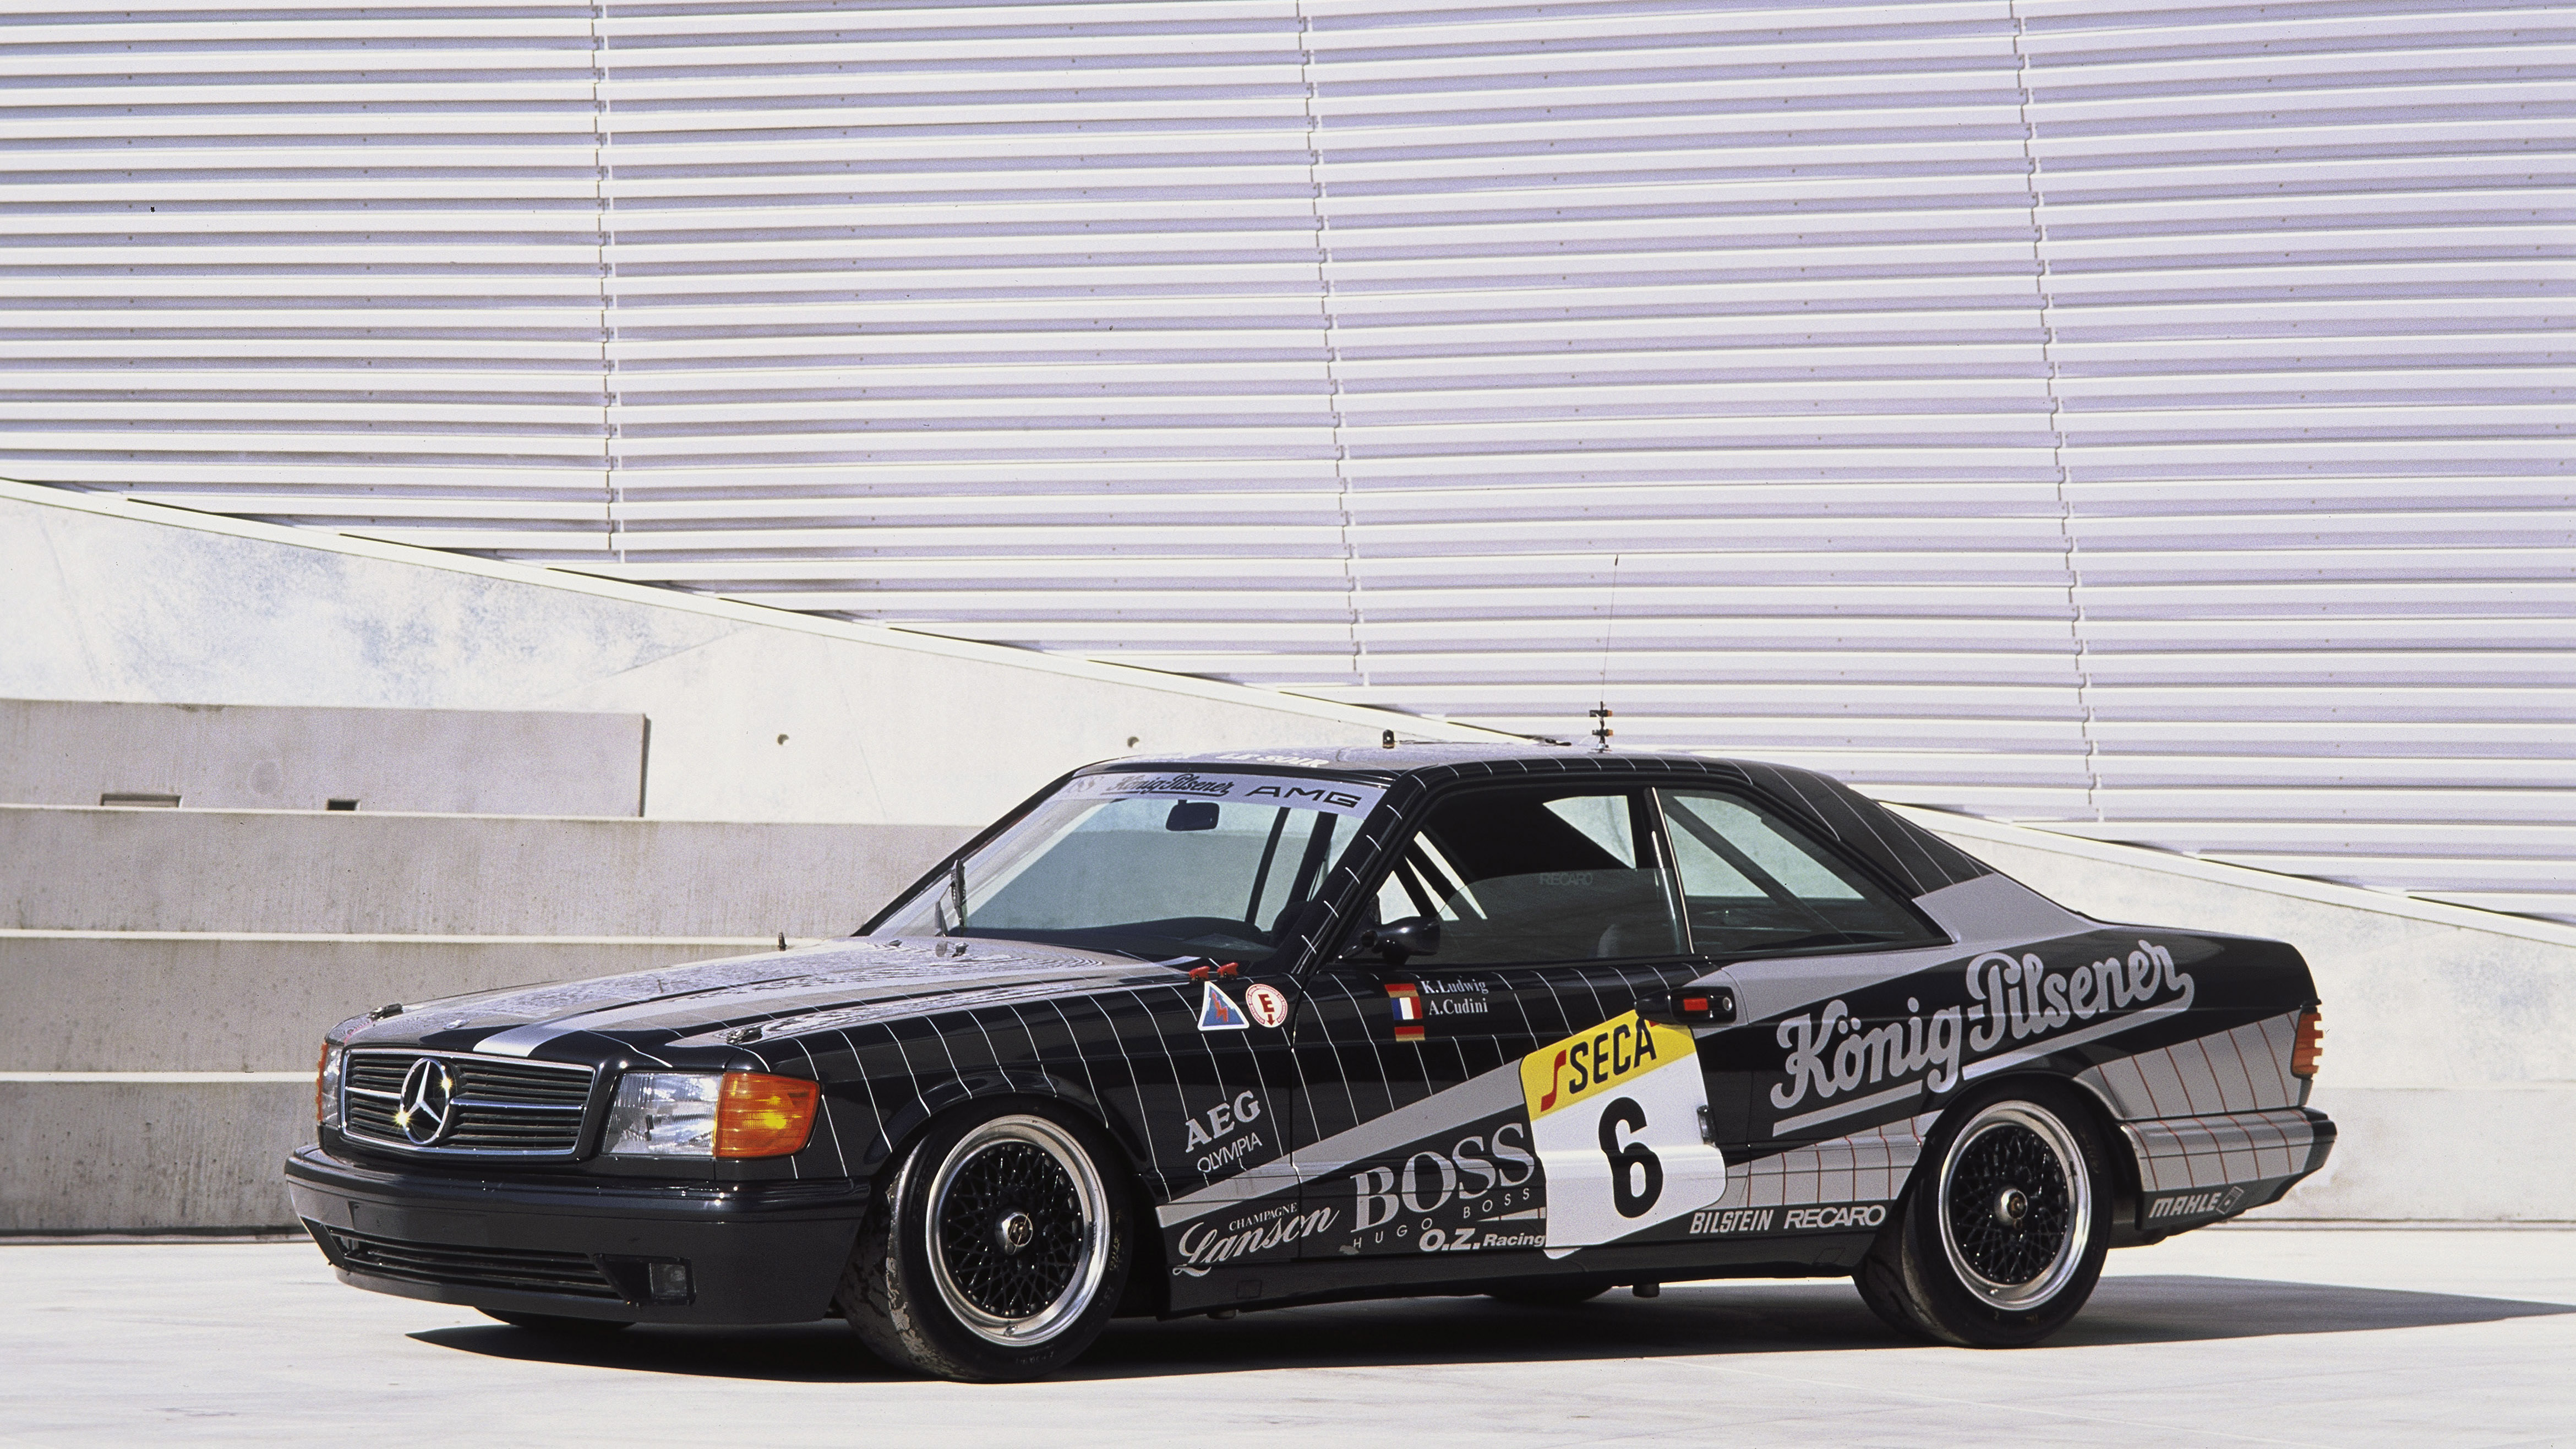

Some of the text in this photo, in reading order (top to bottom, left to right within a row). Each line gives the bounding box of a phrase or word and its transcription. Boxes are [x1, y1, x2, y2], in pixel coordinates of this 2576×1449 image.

[1245, 786, 1362, 808] AMG
[1540, 872, 1593, 886] RECARO
[1420, 978, 1489, 994] K.Ludwig
[1258, 993, 1275, 1013] E
[1429, 998, 1488, 1015] A.Cudini
[1770, 939, 2195, 1109] König-Pilsener
[1185, 1090, 1261, 1153] AEG
[1197, 1132, 1263, 1173] OLYMPIA
[1598, 1097, 1663, 1218] 6
[1350, 1123, 1535, 1233] BOSS
[1229, 1202, 1298, 1231] CHAMPAGNE
[1463, 1187, 1530, 1219] BOSS
[2148, 1192, 2222, 1219] MAHLE
[1689, 1205, 1886, 1234] BILSTEIN RECARO
[1172, 1207, 1340, 1277] Lanson
[1418, 1228, 1546, 1252] O.Z. Racing
